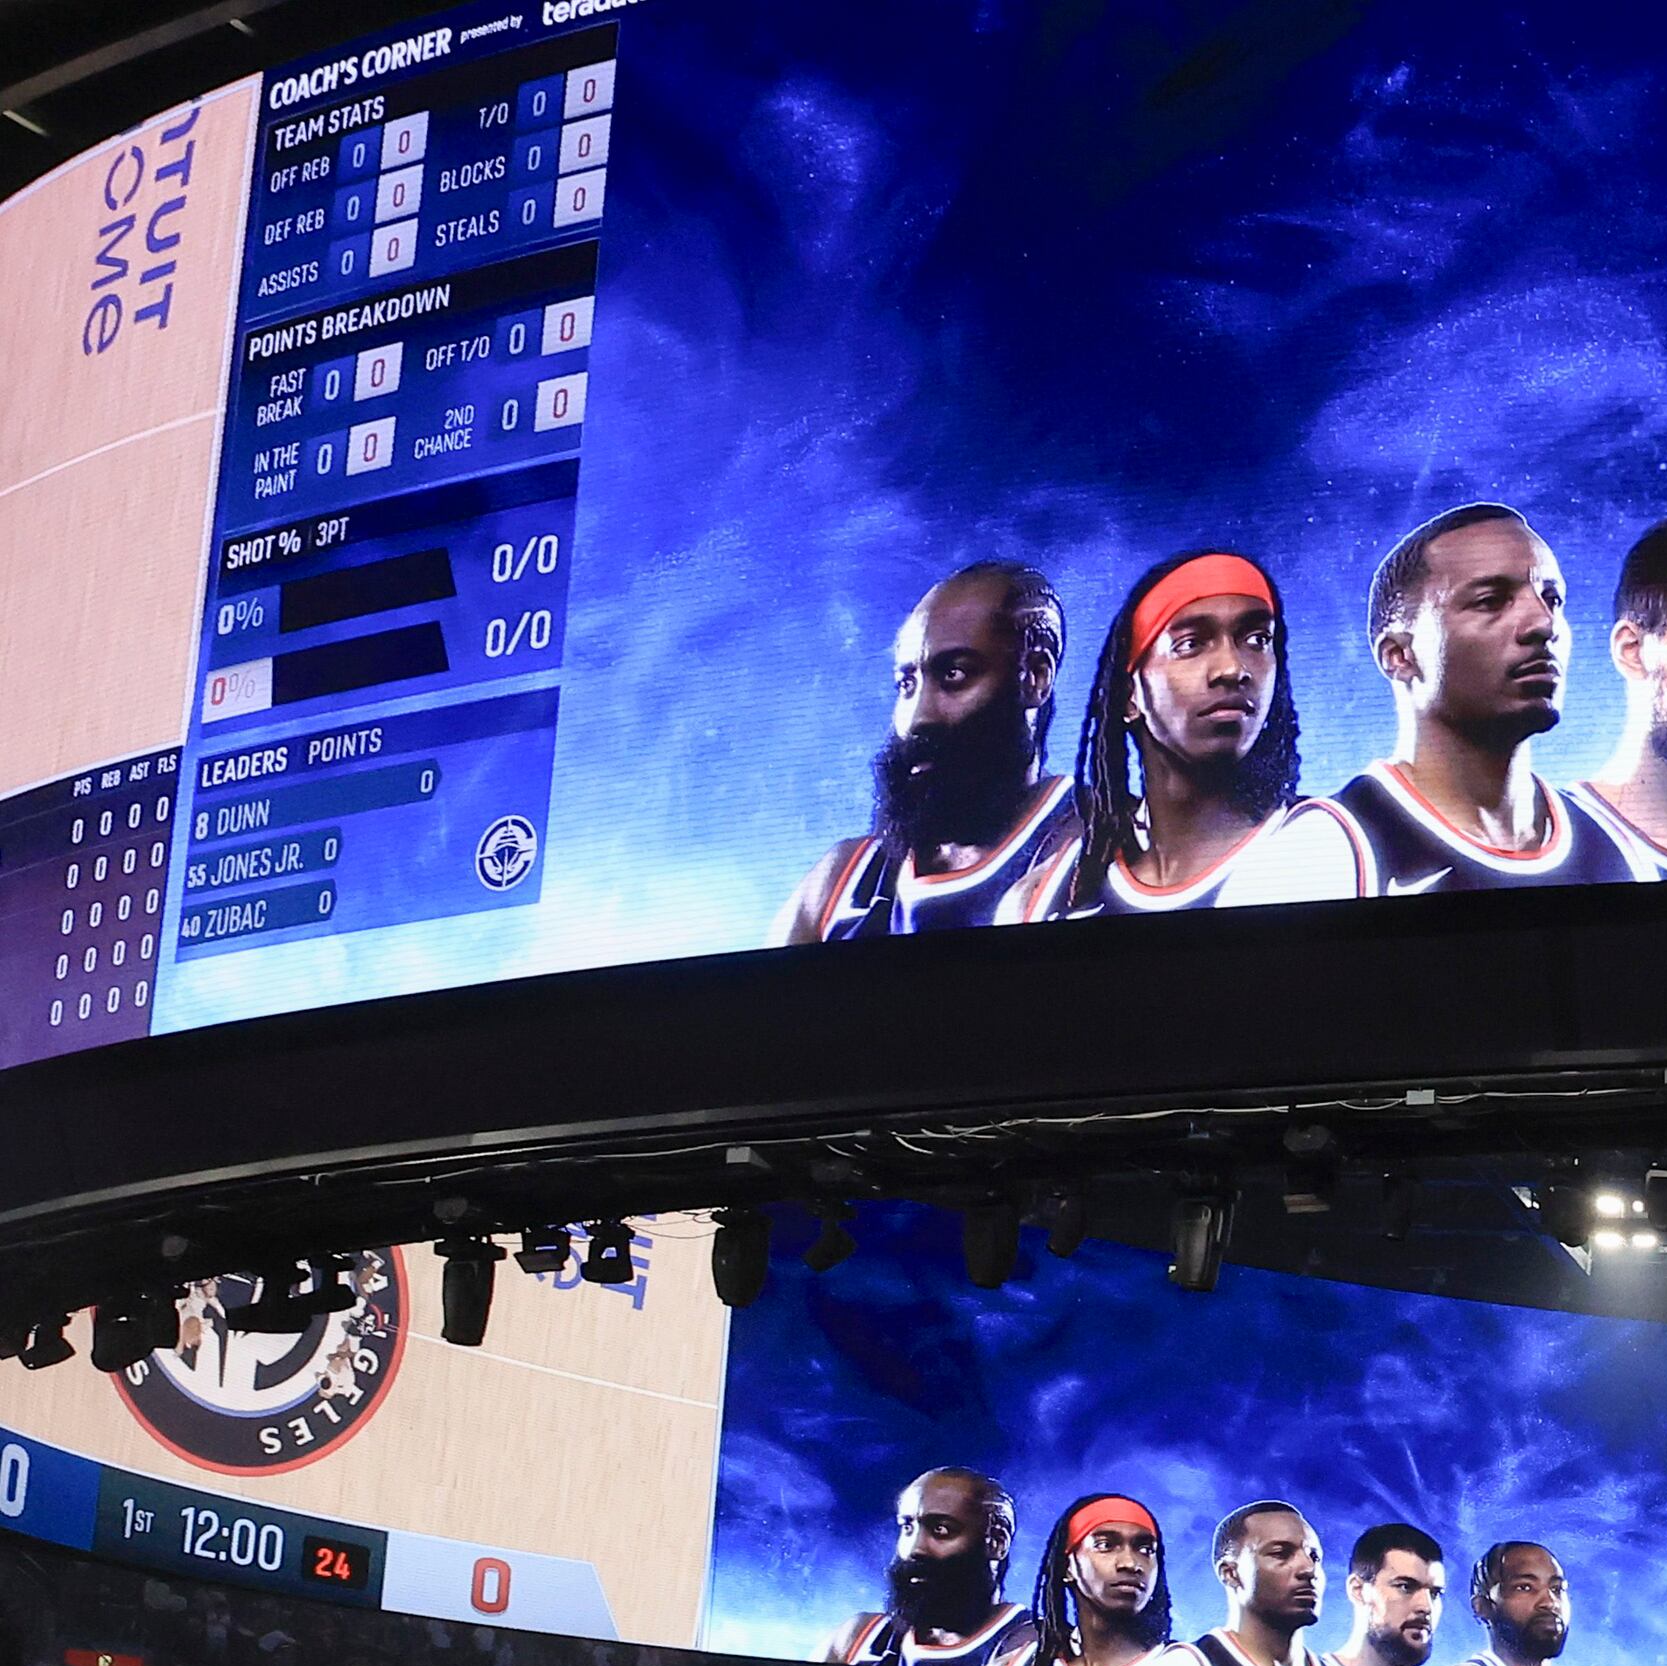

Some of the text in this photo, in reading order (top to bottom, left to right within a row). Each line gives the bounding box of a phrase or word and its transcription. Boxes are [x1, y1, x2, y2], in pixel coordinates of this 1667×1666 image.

[270, 15, 523, 113] COACH'S CORNER presented by
[275, 96, 384, 151] TEAM STATS
[440, 156, 505, 192] BLOCKS
[436, 210, 499, 246] STEALS
[258, 262, 318, 296] ASSISTS
[249, 284, 450, 360] POINTS BREAKDOWN
[202, 728, 381, 787] LEADERS POINTS
[195, 799, 270, 839] 8 DUNN
[124, 1499, 350, 1579] 1ST 12:00 24
